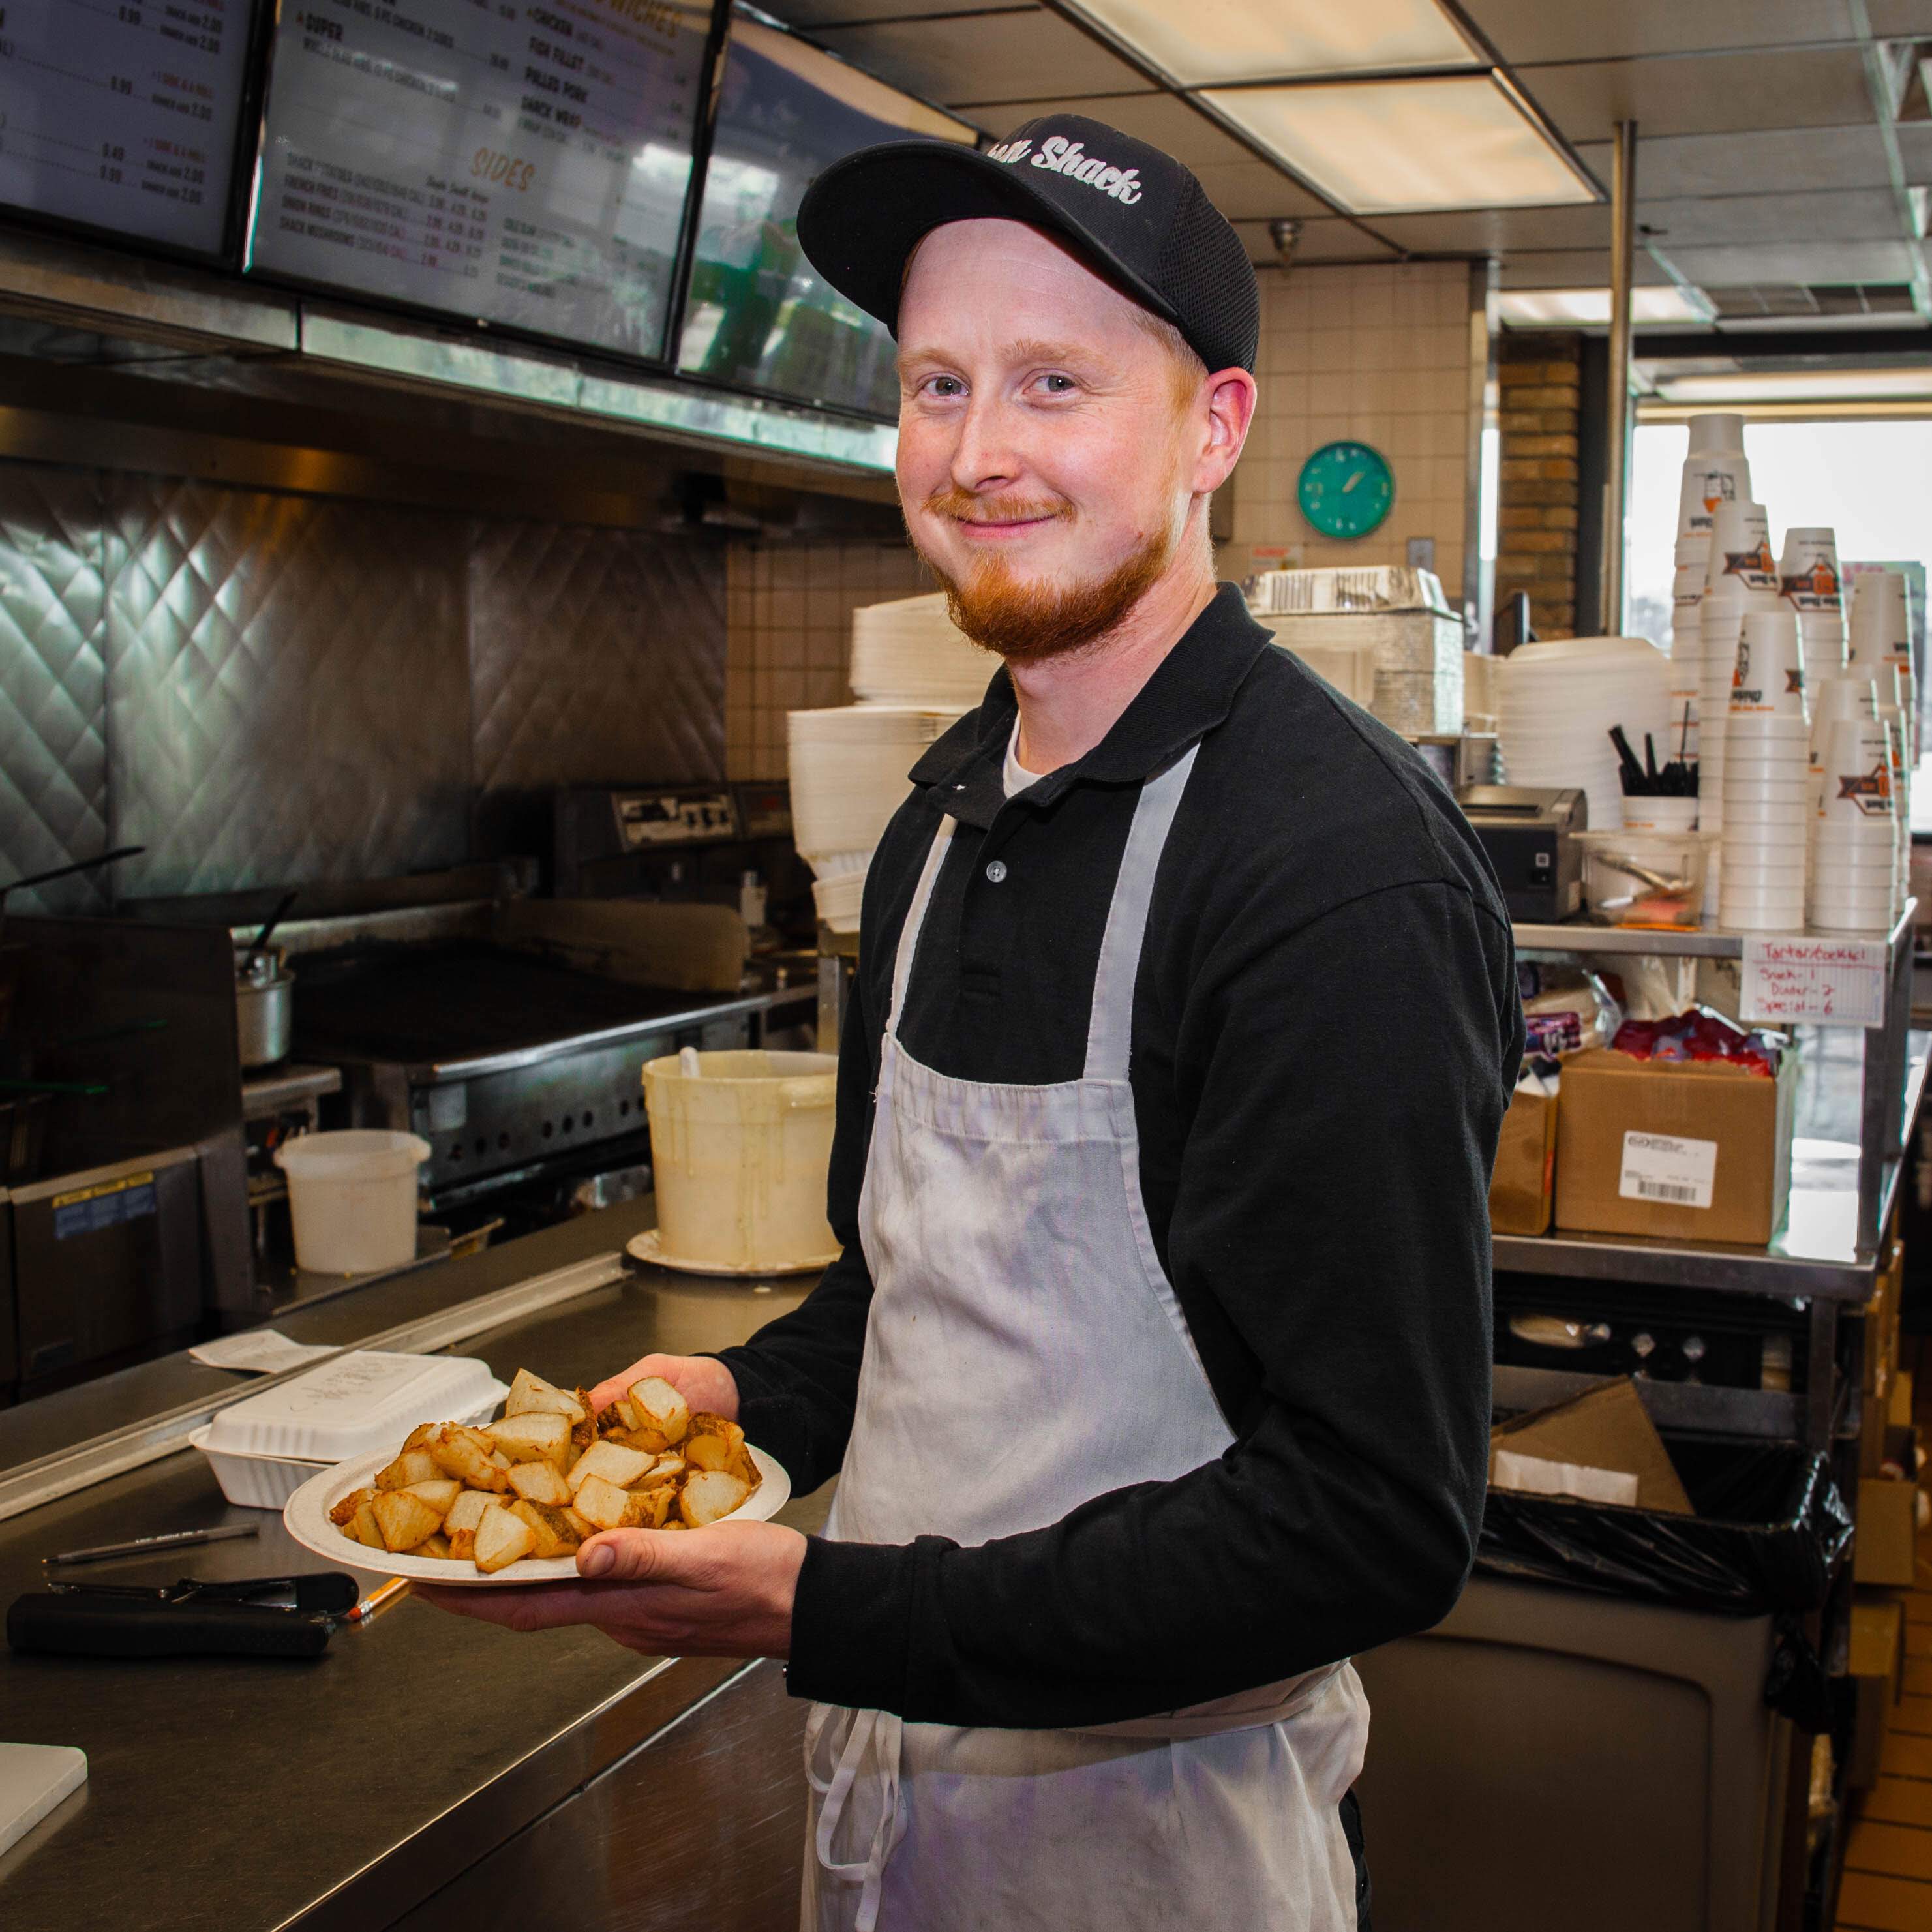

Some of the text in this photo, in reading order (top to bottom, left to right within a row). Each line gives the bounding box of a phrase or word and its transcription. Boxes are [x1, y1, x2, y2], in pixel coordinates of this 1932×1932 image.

[305, 12, 343, 42] SUPER
[470, 147, 535, 191] SIDES
[1031, 136, 1142, 204] Shack
